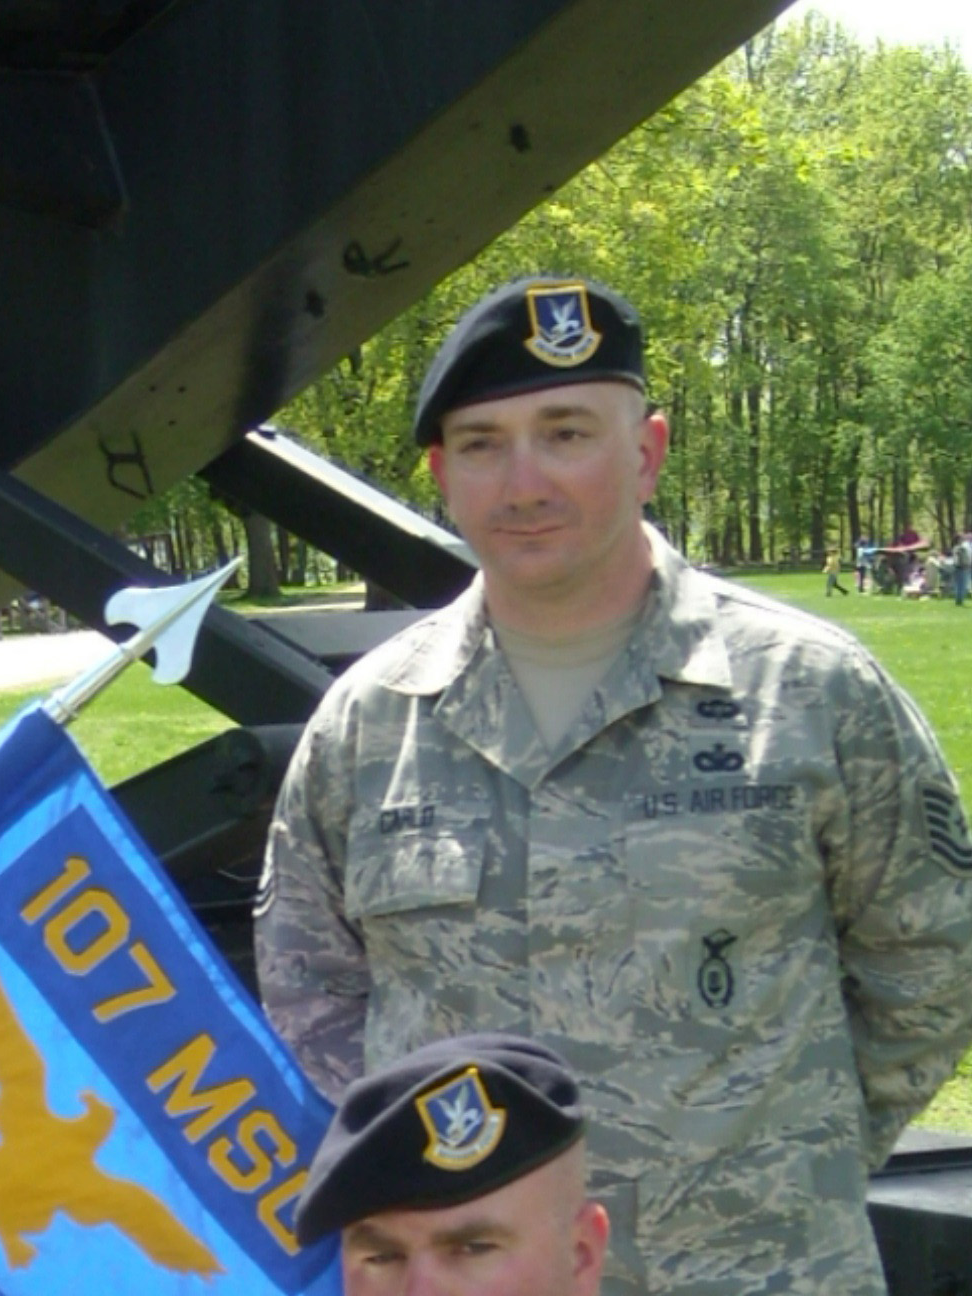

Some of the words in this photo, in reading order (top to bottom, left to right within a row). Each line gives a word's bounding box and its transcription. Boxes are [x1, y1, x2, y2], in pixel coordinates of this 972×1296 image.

[690, 787, 725, 813] AIR
[730, 784, 797, 813] FORCE
[20, 856, 177, 1024] 107
